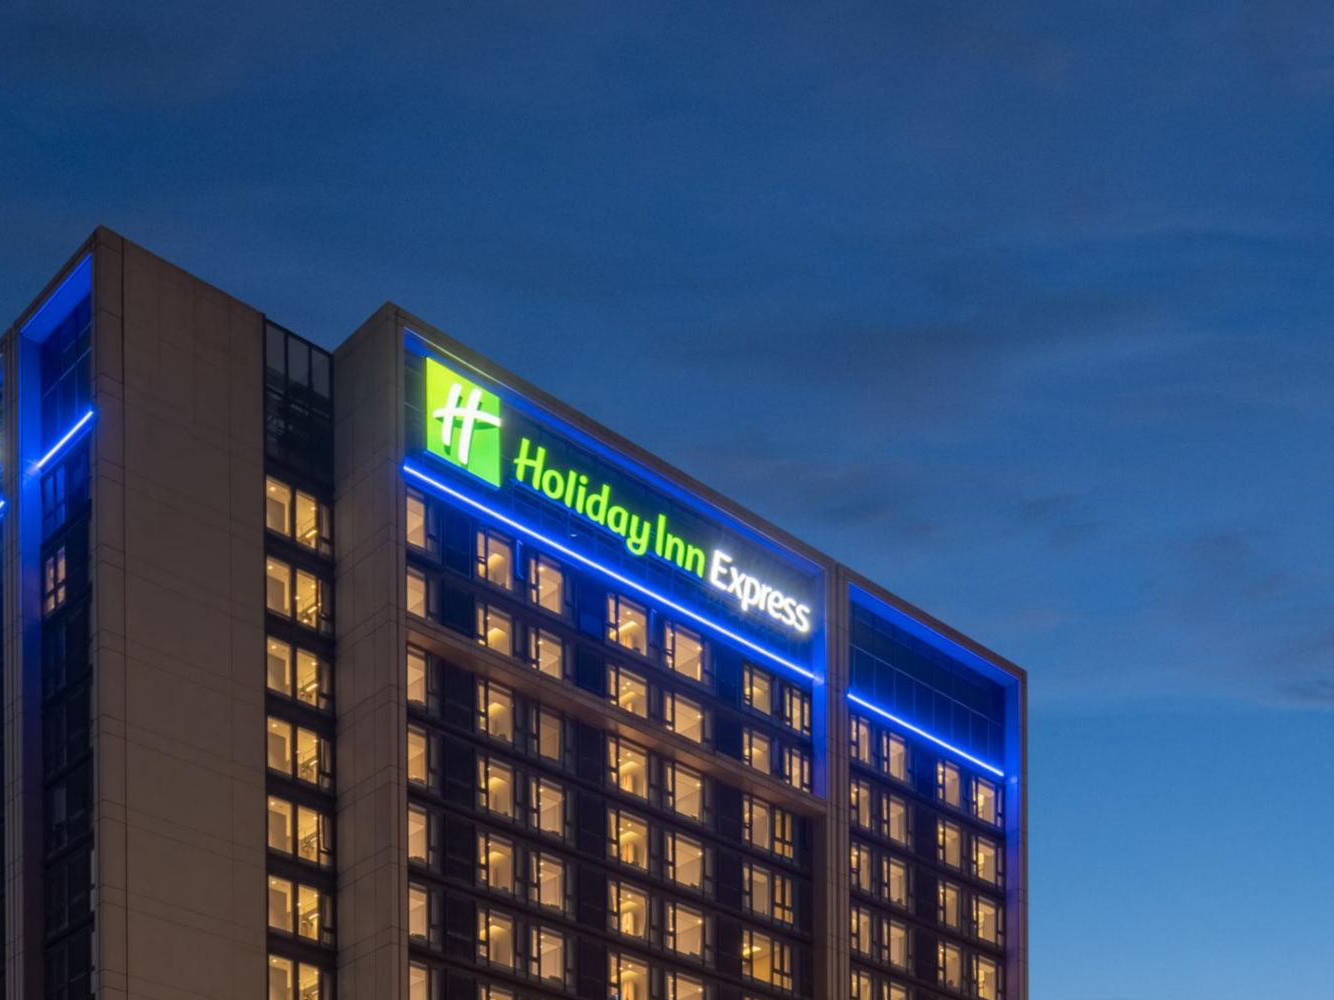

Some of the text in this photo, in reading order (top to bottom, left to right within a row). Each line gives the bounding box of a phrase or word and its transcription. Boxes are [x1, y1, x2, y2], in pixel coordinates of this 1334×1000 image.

[514, 438, 811, 633] Holiday Inn Express
